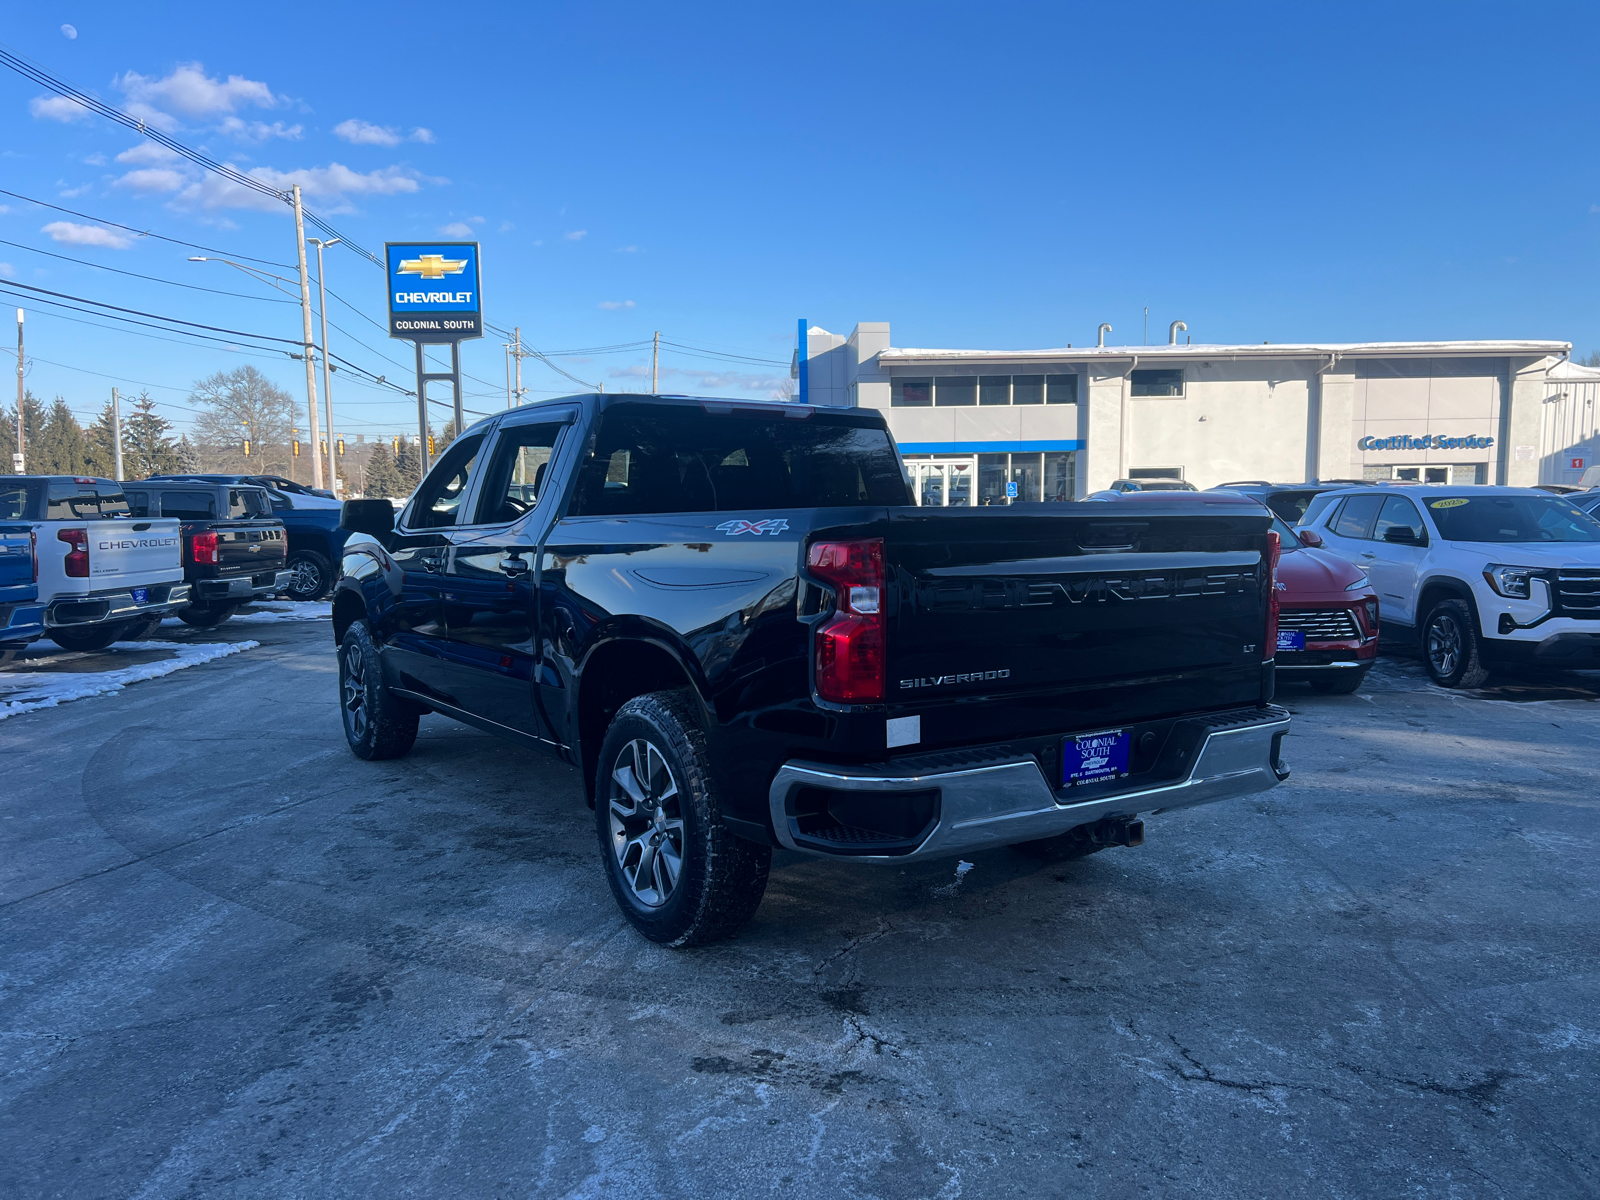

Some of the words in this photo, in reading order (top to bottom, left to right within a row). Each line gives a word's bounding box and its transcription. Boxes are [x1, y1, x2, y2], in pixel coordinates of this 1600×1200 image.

[395, 292, 472, 303] CHEVROLET
[396, 321, 441, 329] COLONIAL
[443, 320, 474, 329] SOUTH
[1364, 434, 1432, 450] Certified
[1437, 434, 1495, 449] Service
[1574, 459, 1580, 468] 1
[1438, 499, 1463, 508] 2025
[99, 538, 177, 550] CHEVROLET
[921, 571, 1254, 611] CHEVROLET
[1243, 644, 1256, 653] LT
[900, 668, 1010, 689] SILVERADO
[1076, 736, 1117, 751] COLONIAL
[1081, 746, 1110, 759] SOUTH
[1076, 777, 1099, 786] COLONIAL
[1099, 774, 1116, 782] SOUTH
